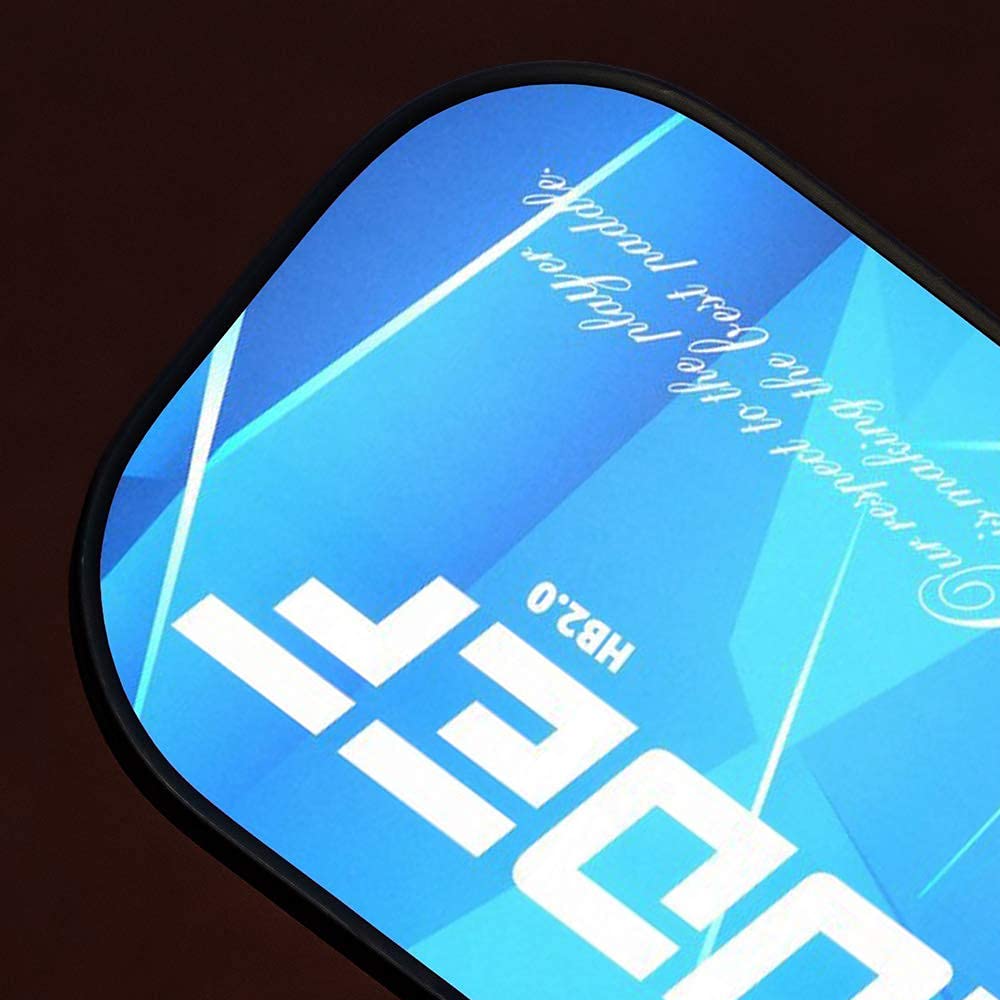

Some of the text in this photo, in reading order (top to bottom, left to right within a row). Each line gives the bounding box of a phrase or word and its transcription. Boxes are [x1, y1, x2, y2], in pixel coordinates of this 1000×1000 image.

[522, 167, 698, 273] paddle.
[521, 246, 682, 343] player
[667, 284, 770, 353] best
[668, 357, 742, 404] the
[739, 402, 782, 433] to
[759, 353, 833, 399] the
[770, 440, 916, 533] respect
[829, 398, 983, 508] making
[527, 581, 635, 674] HB2.0
